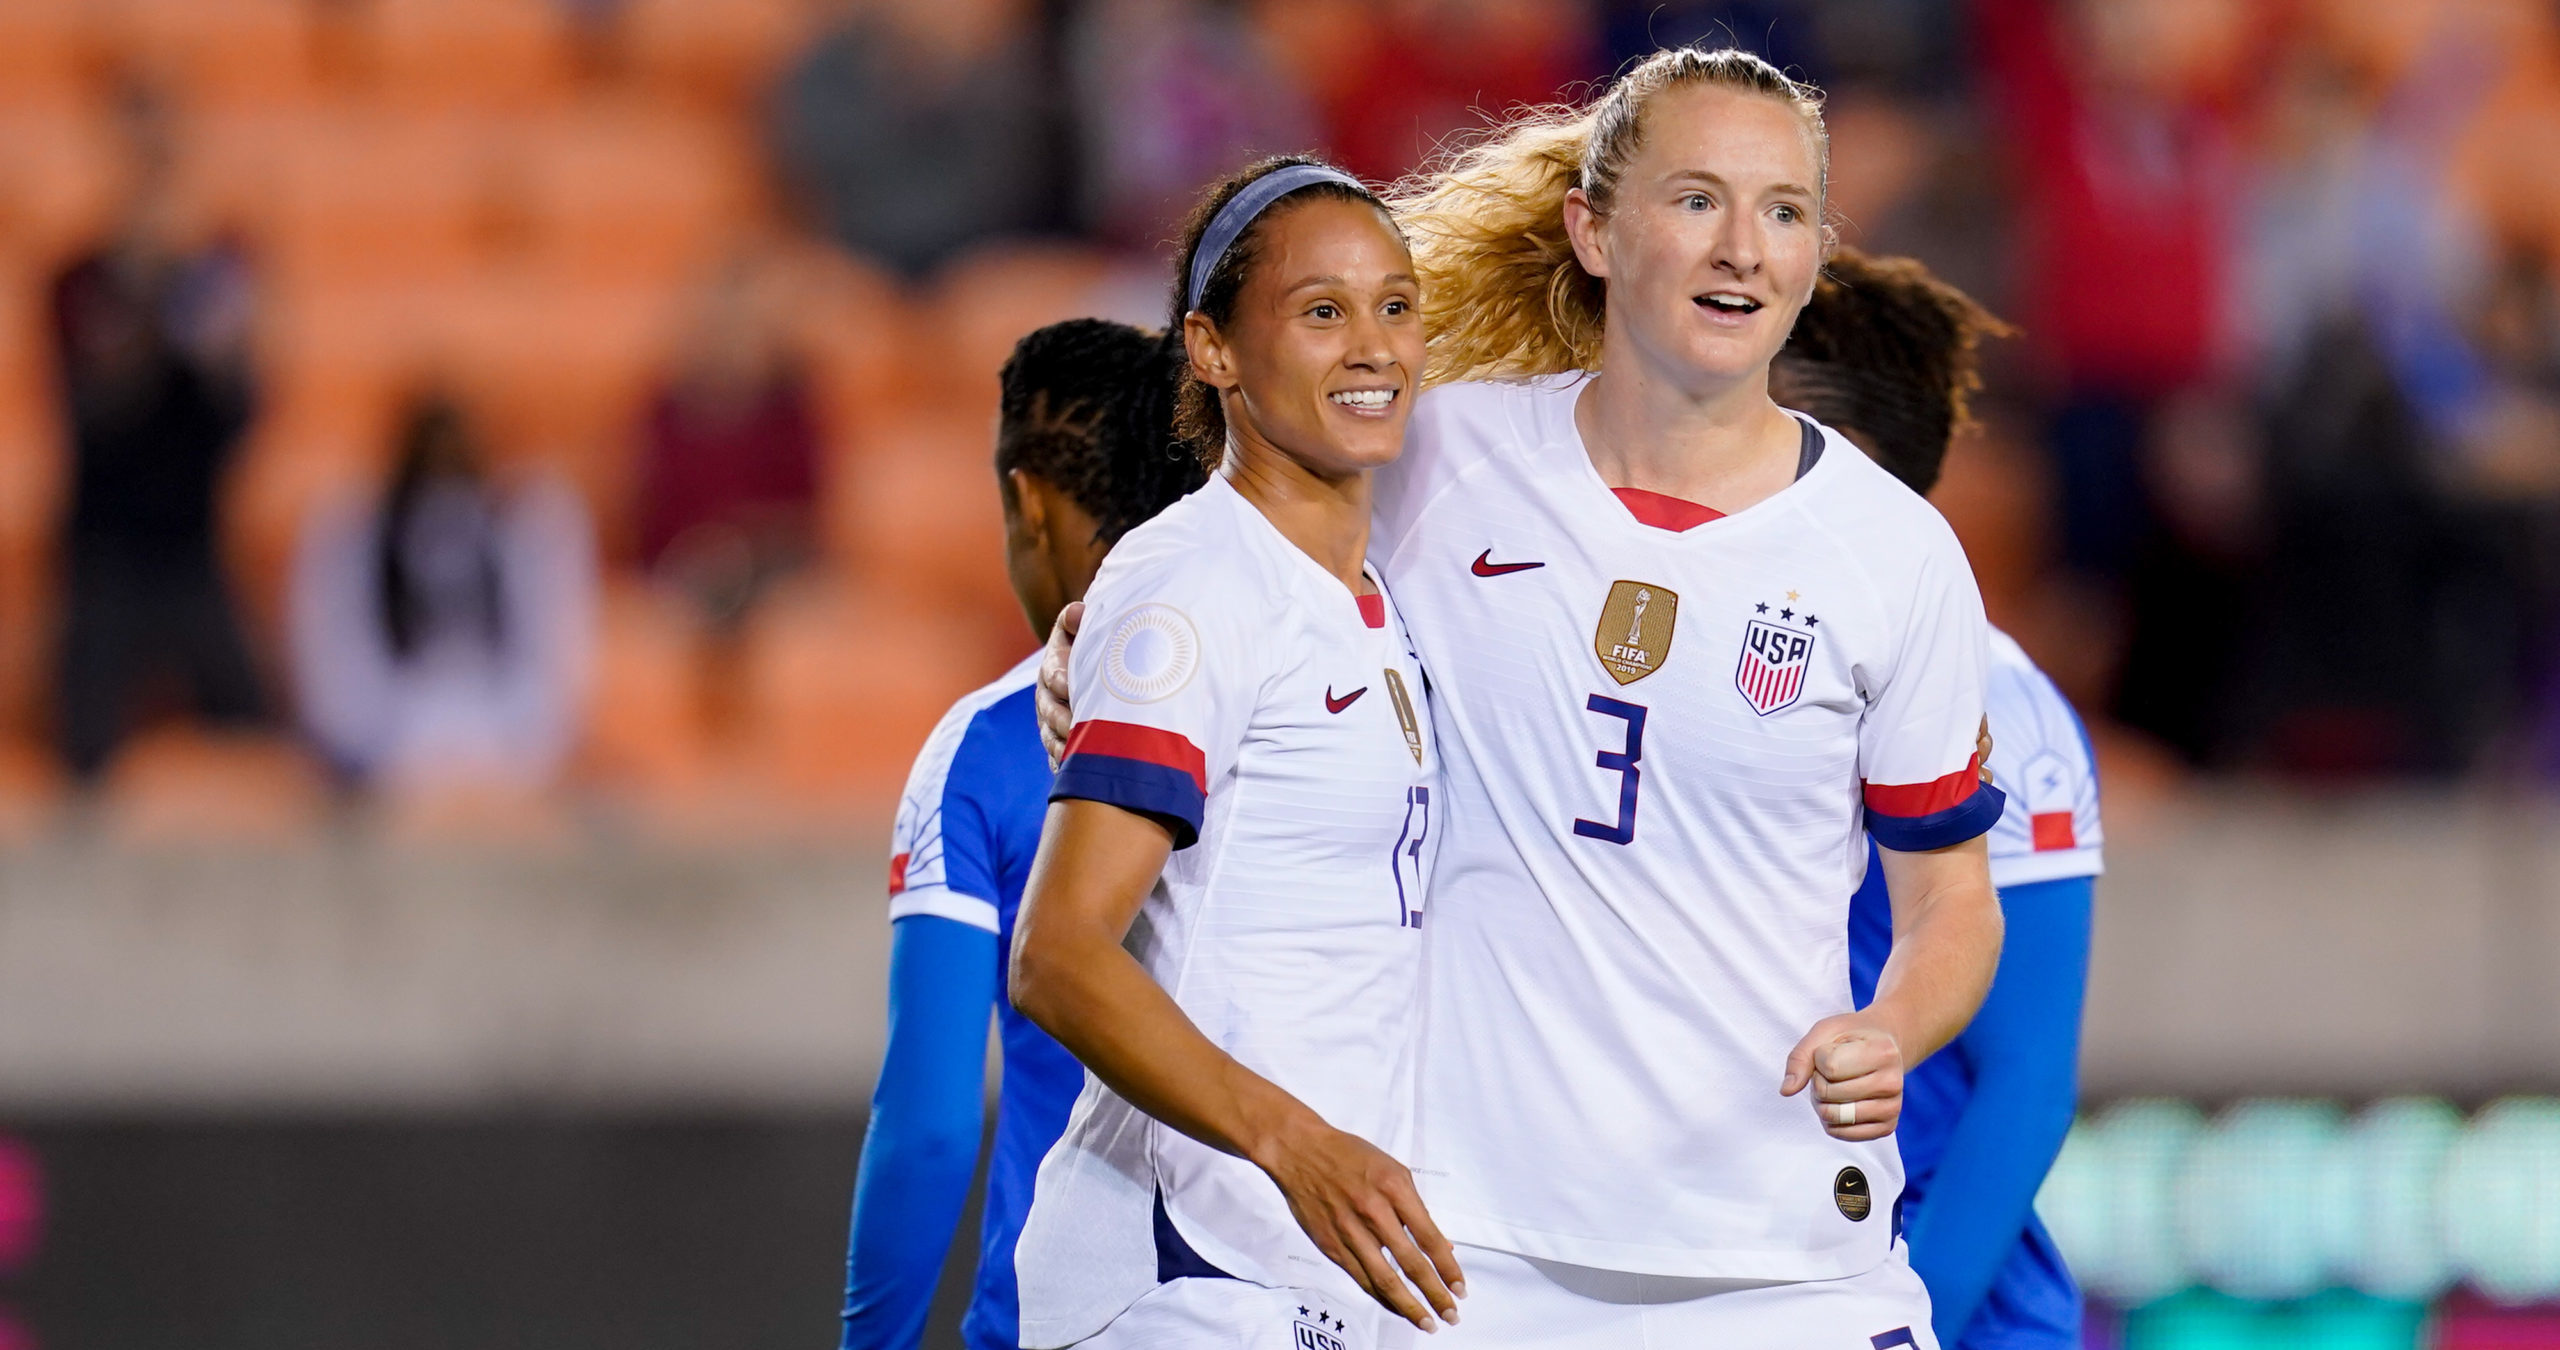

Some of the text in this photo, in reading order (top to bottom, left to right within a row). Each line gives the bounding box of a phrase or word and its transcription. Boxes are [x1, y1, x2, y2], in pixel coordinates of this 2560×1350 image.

[1612, 644, 1646, 664] FIFA
[1751, 627, 1807, 665] USA
[1616, 664, 1637, 675] 2019
[1573, 693, 1648, 846] 3
[1392, 785, 1430, 930] 13
